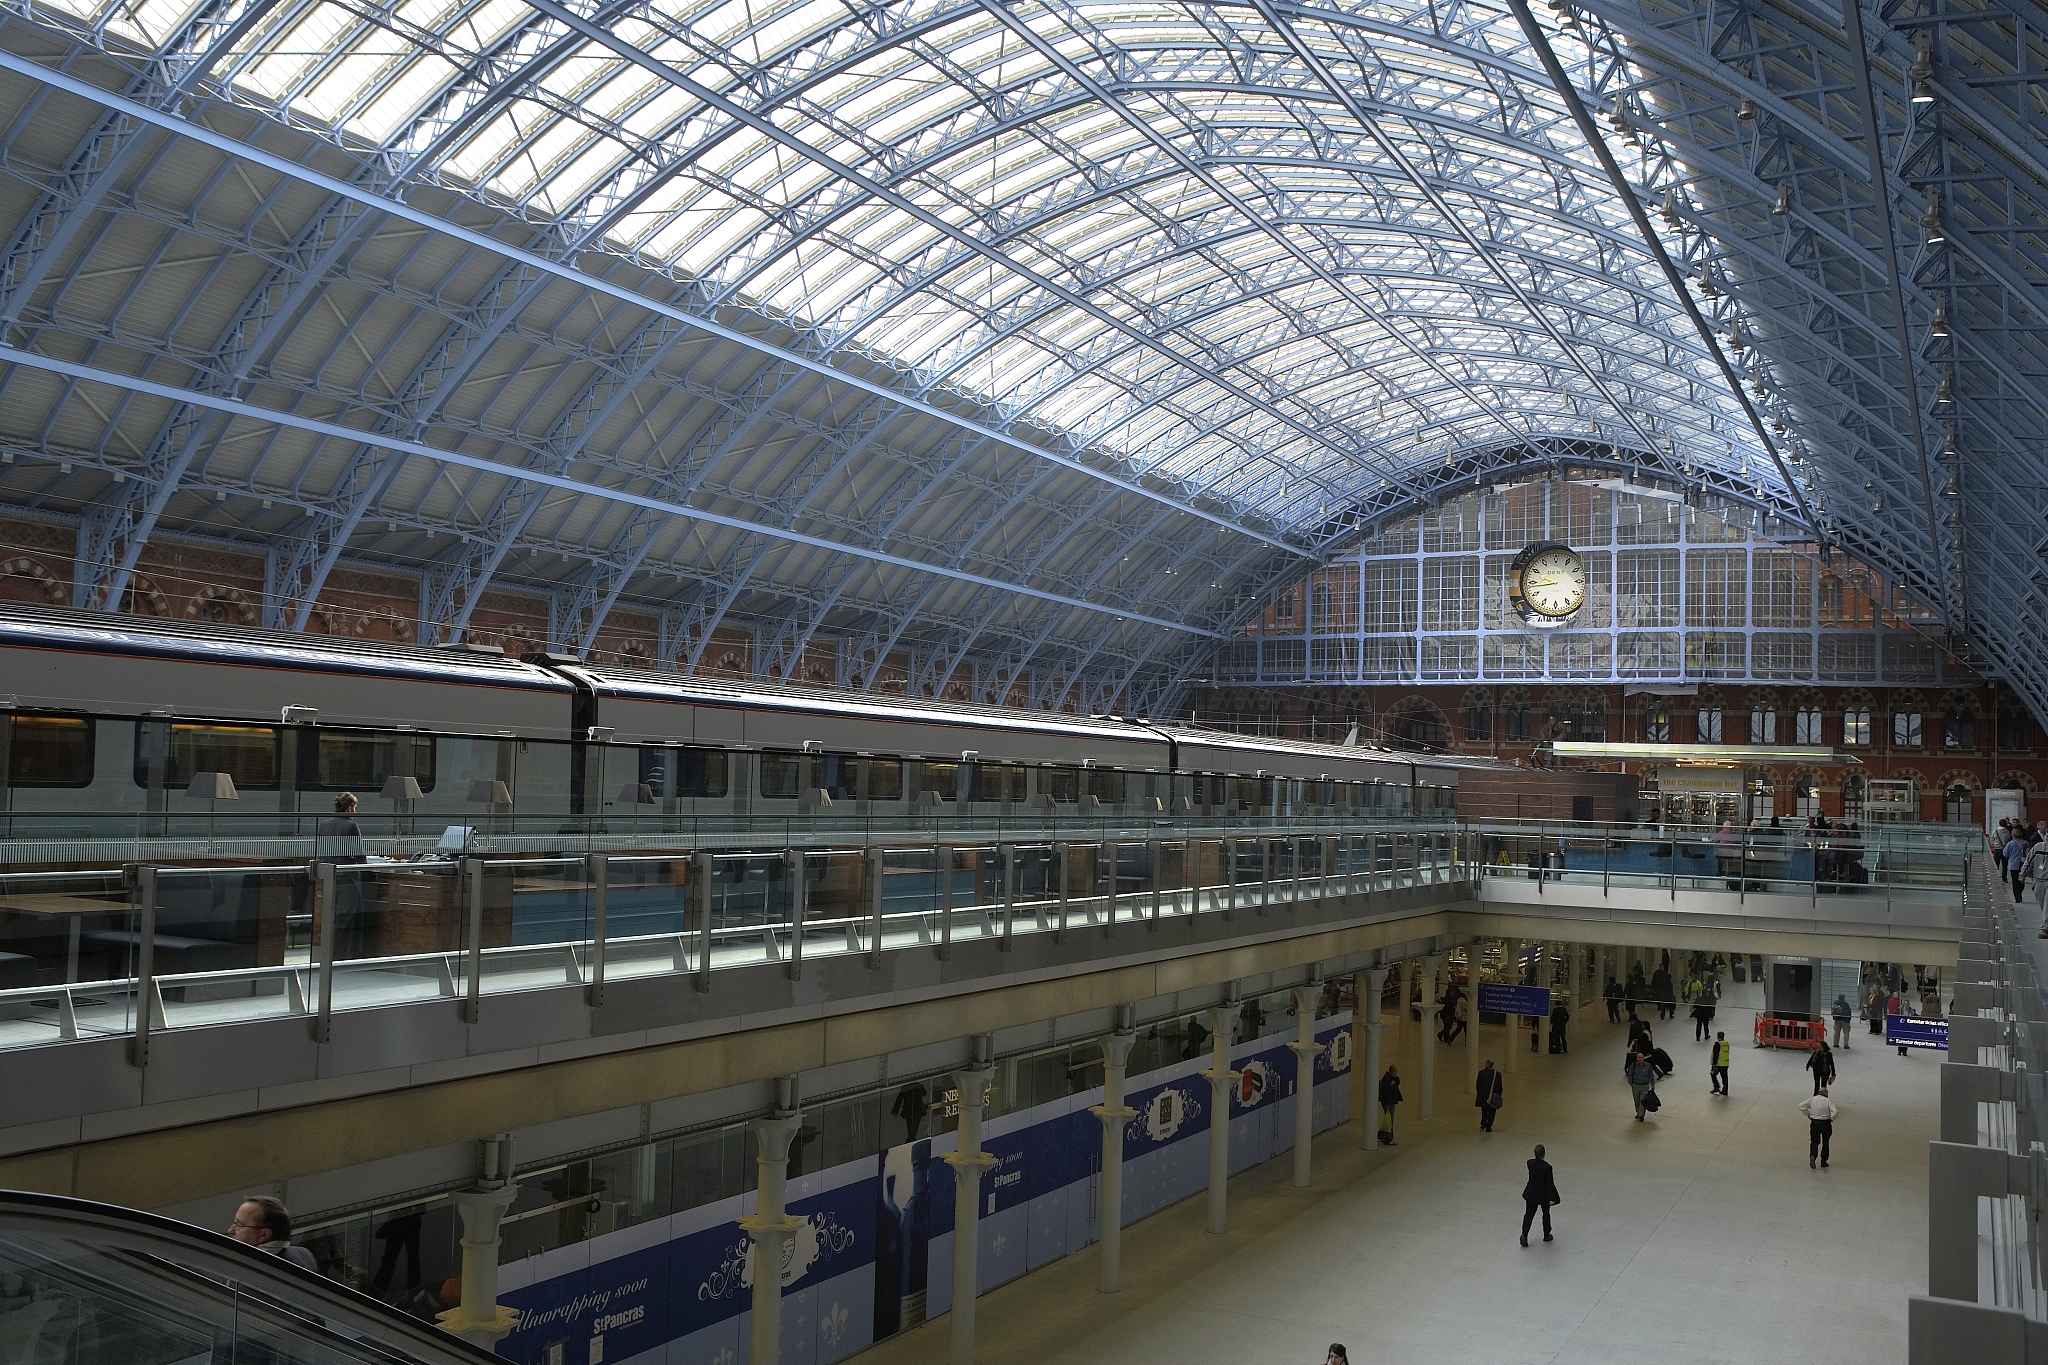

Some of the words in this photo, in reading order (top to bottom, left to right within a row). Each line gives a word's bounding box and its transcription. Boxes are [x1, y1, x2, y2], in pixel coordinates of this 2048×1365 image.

[1663, 778, 1676, 787] the
[1677, 779, 1723, 788] champagne
[1724, 780, 1739, 788] bar
[1485, 985, 1509, 993] Underground
[515, 1289, 612, 1334] Unwrapping
[614, 1276, 649, 1300] soon
